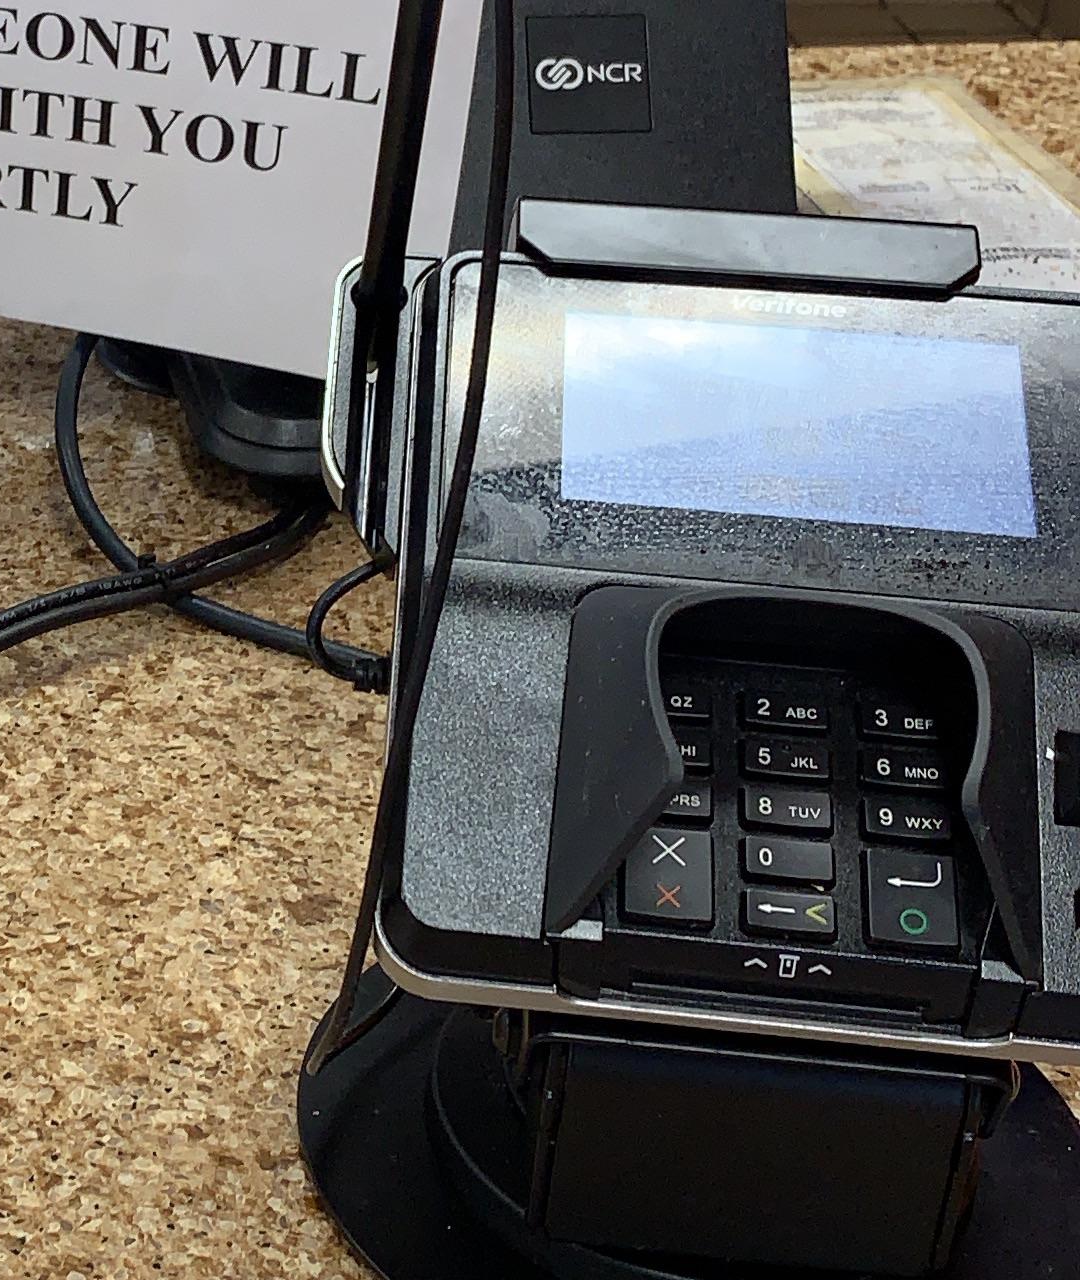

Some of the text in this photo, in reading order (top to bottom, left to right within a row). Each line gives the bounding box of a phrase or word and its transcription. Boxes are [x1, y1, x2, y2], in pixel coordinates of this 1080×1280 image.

[192, 31, 382, 106] WILL
[587, 63, 642, 83] NCR
[134, 103, 288, 171] YOU
[730, 294, 847, 318] Verifone
[670, 696, 693, 708] QZ
[757, 698, 817, 720] 2 ABC
[875, 709, 934, 730] 3 DEF
[679, 745, 696, 757] HI
[758, 747, 818, 770] 5 JKL
[877, 758, 939, 780] 6 MNO
[758, 796, 821, 819] 8 TUV
[879, 808, 943, 830] 9 WXY
[759, 847, 773, 866] 0
